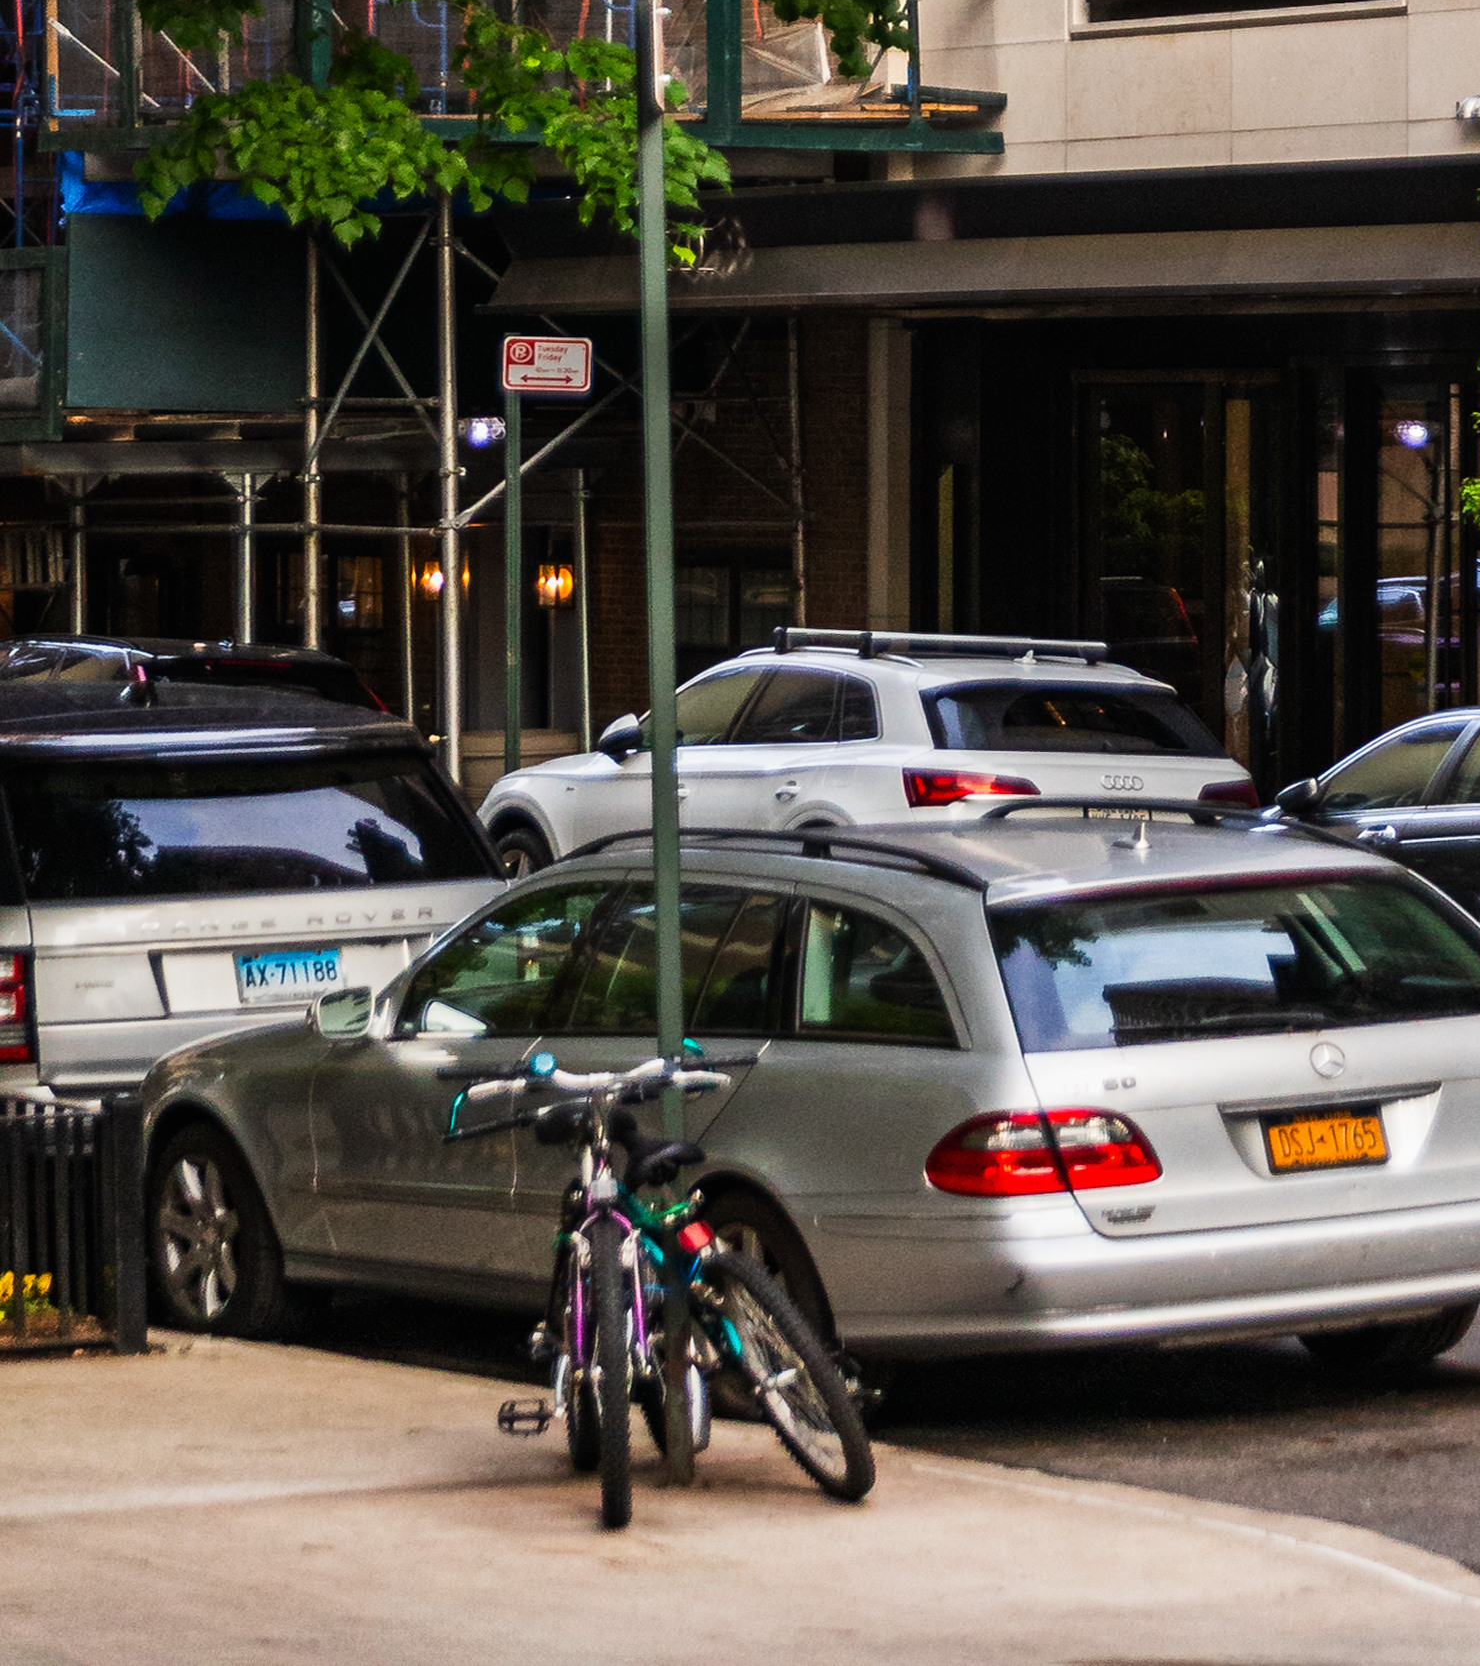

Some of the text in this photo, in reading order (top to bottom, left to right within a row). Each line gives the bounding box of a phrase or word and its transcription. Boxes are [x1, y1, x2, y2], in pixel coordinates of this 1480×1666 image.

[538, 345, 568, 354] Tuesday
[538, 354, 562, 362] Friday
[307, 907, 433, 925] ROVER
